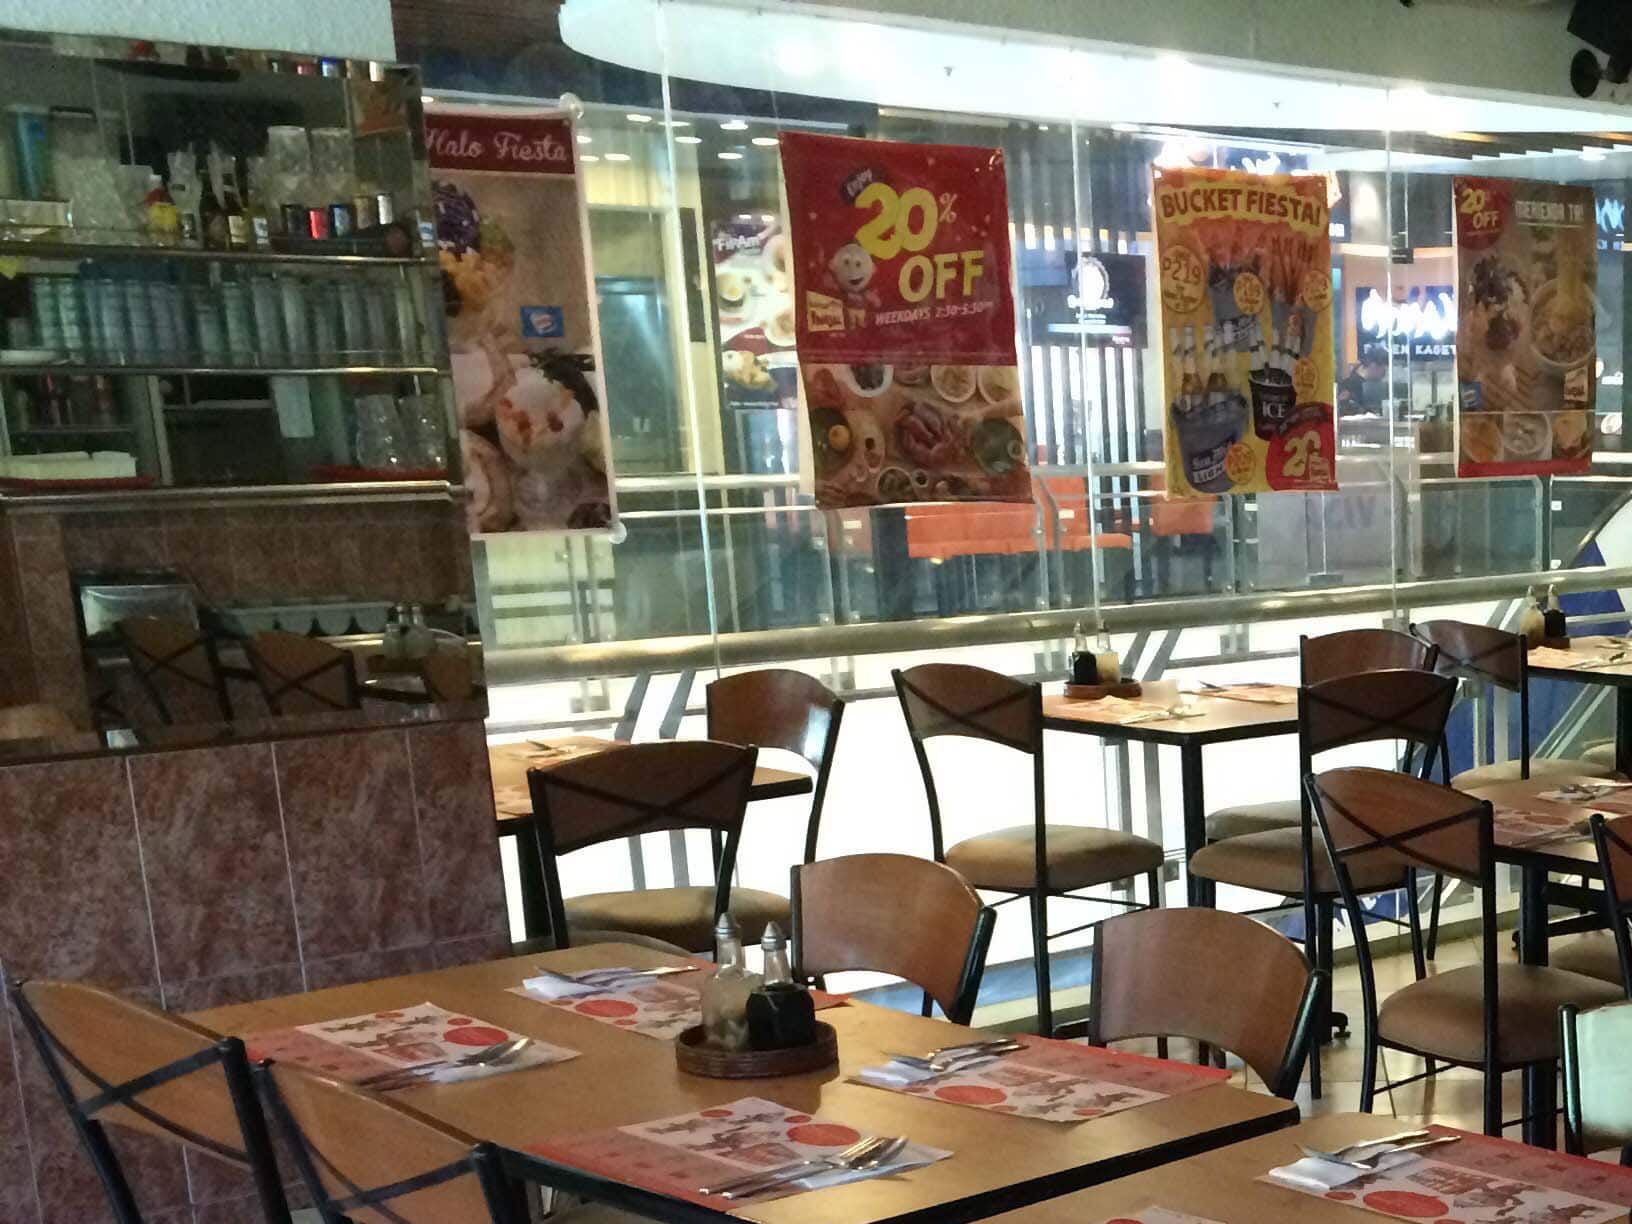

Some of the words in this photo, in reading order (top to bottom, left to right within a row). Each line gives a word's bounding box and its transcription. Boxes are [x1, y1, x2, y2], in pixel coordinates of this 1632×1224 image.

[494, 131, 567, 161] Fiesta
[1160, 188, 1242, 218] BUCKET
[1472, 210, 1500, 229] OFF
[898, 250, 984, 302] OFF
[875, 306, 931, 326] WEEKDAYS
[1262, 402, 1287, 419] ICE
